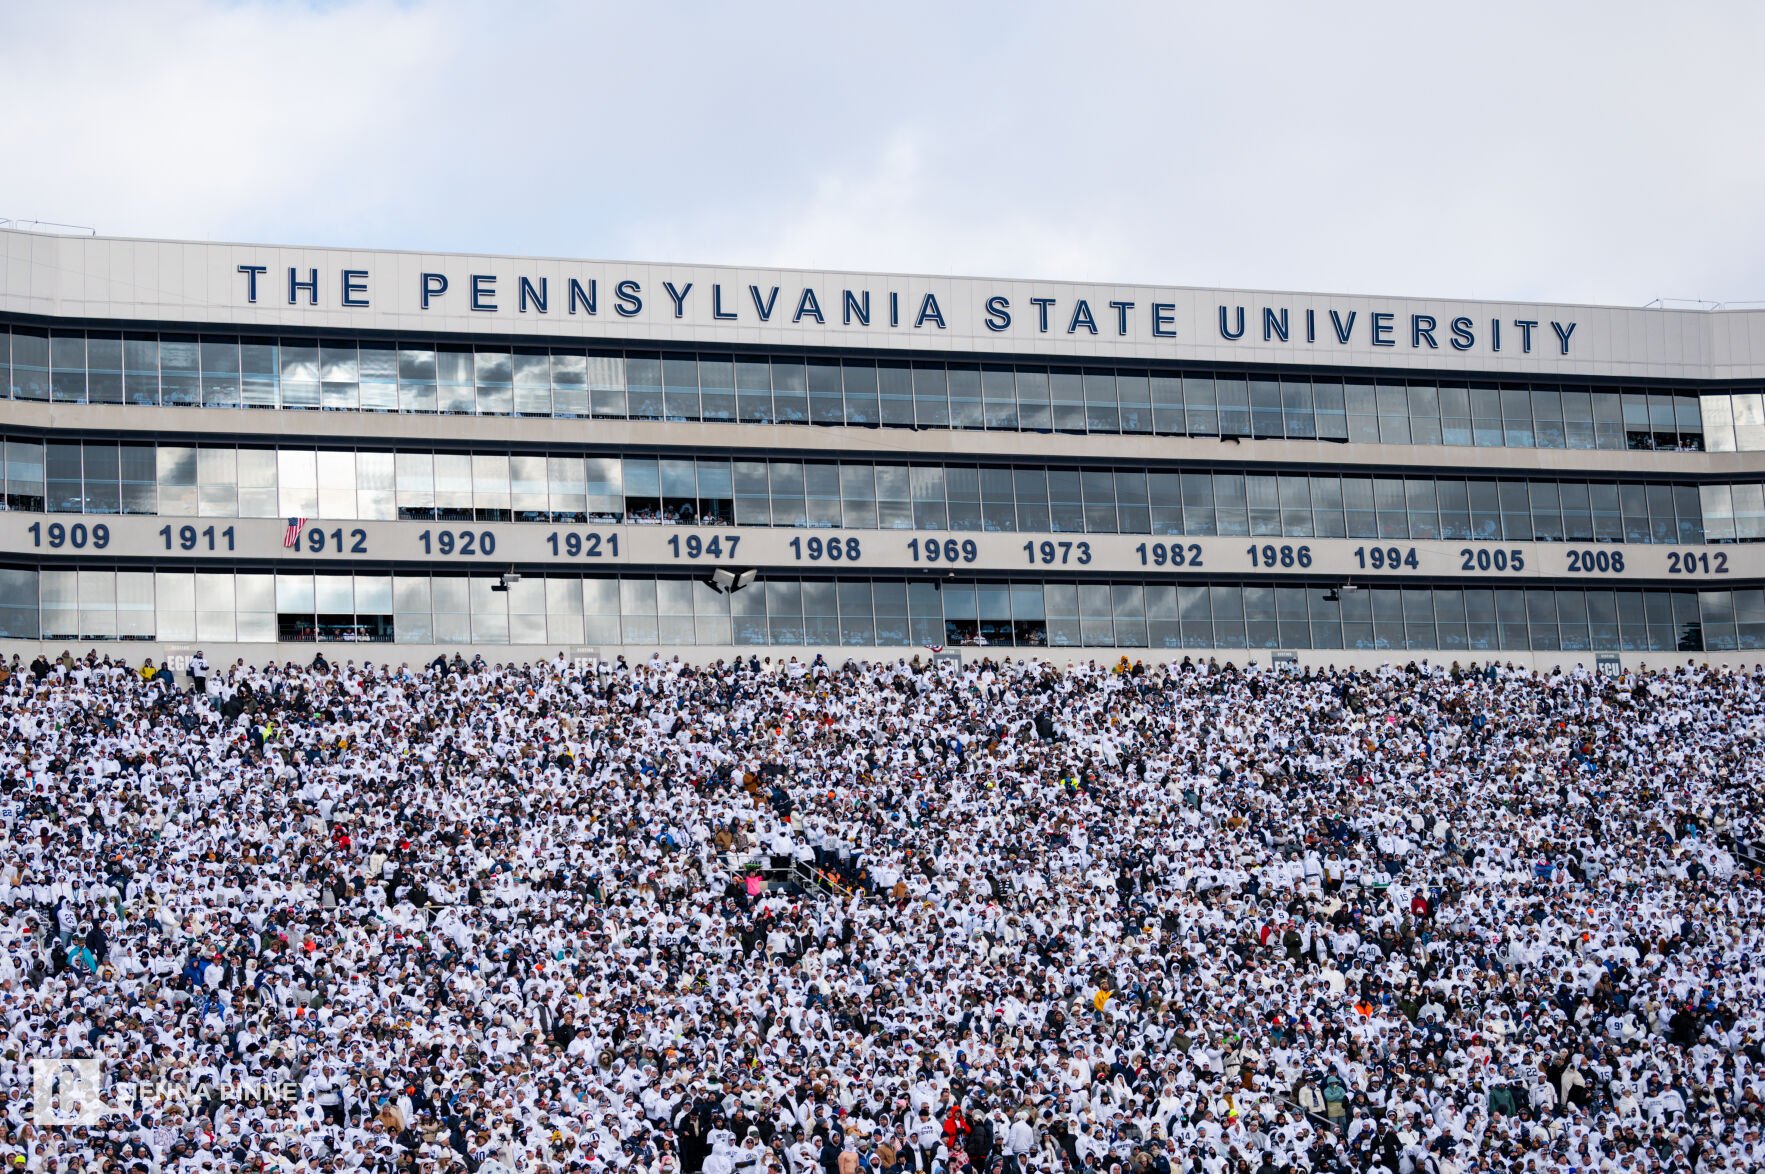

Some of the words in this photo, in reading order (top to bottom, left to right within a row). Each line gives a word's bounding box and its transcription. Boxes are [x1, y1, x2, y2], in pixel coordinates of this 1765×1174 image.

[237, 265, 370, 307] THE
[420, 272, 947, 330] PENNSYLVANIA
[984, 296, 1177, 339] STATE
[1218, 304, 1577, 356] UNIVERSITY
[28, 522, 110, 549] 1909
[159, 525, 235, 550] 1911
[419, 530, 496, 555] 1920
[546, 533, 619, 556] 1921
[667, 535, 741, 558] 1947
[789, 537, 861, 560] 1968
[907, 539, 978, 562] 1969
[1023, 541, 1092, 564] 1973
[1135, 543, 1204, 566] 1982
[1246, 545, 1313, 568] 1986
[1354, 547, 1419, 569] 1994
[1460, 549, 1525, 571] 2005
[1566, 550, 1625, 572] 2008
[1667, 552, 1729, 573] 2012
[1598, 663, 1620, 676] ECU
[1614, 1022, 1624, 1030] 91
[271, 1072, 277, 1082] 6
[1526, 1068, 1537, 1077] 22
[1600, 1072, 1609, 1080] 15
[1632, 1085, 1638, 1093] 3
[1181, 1132, 1190, 1140] 14
